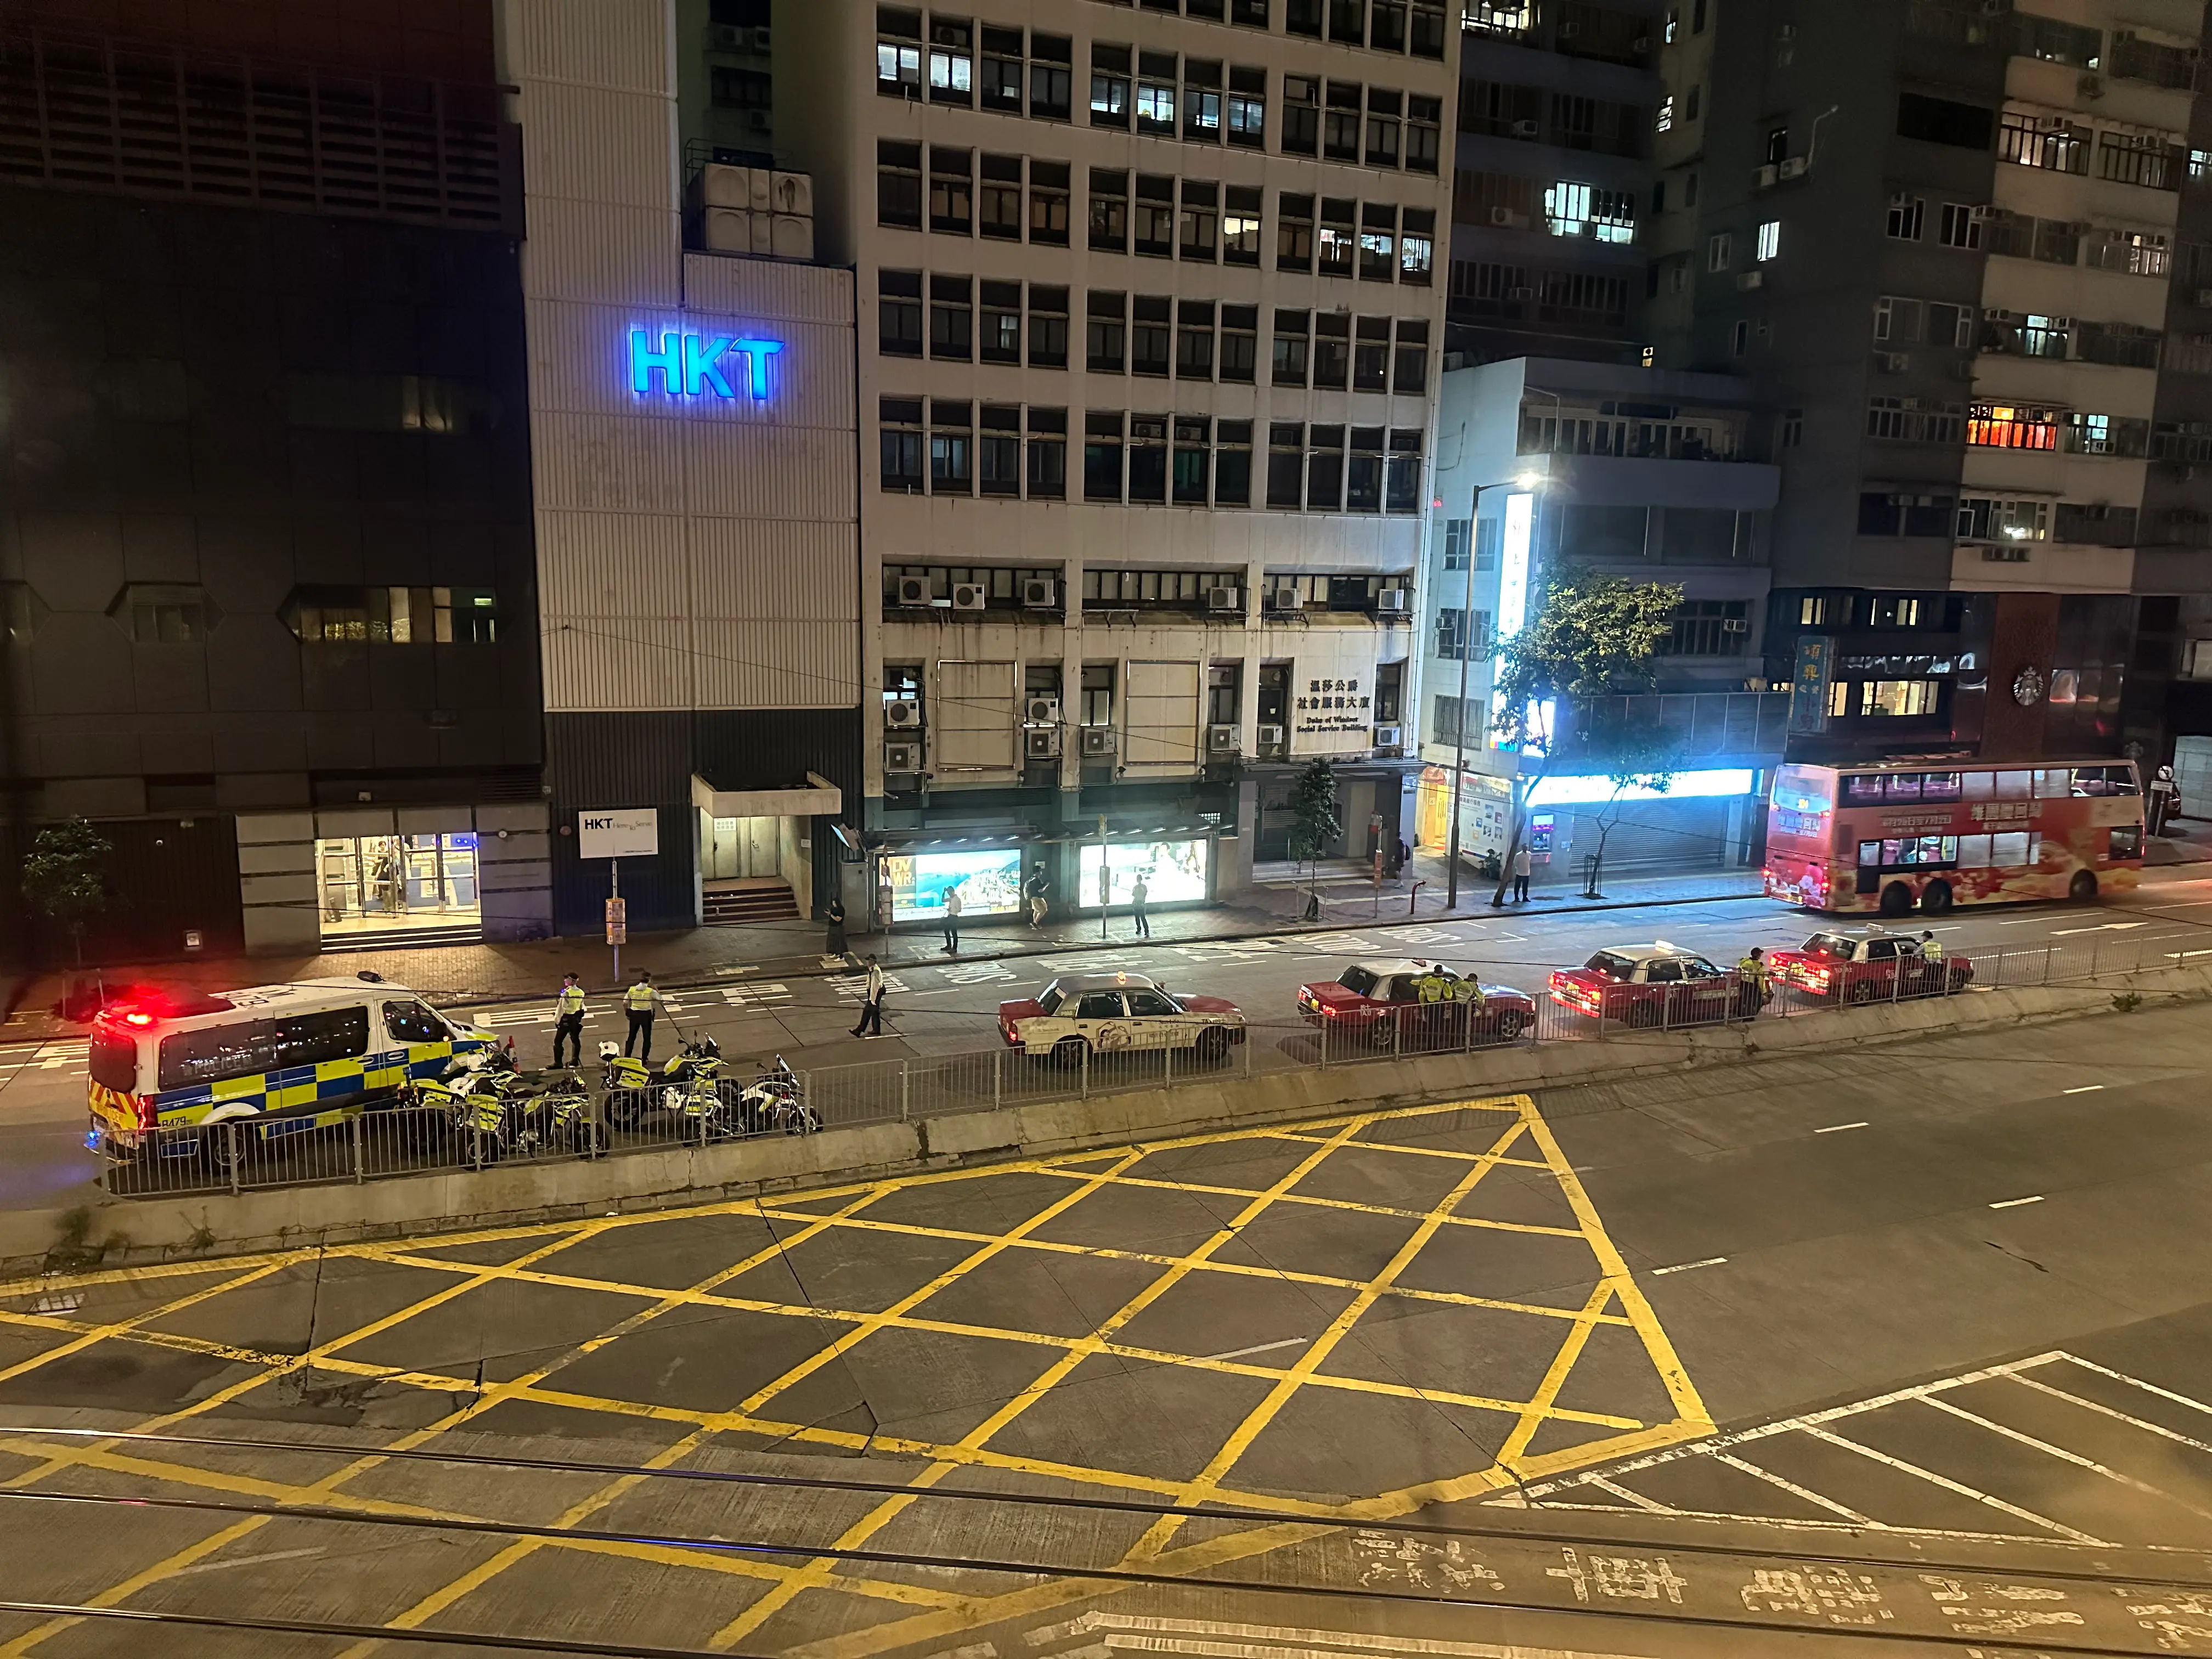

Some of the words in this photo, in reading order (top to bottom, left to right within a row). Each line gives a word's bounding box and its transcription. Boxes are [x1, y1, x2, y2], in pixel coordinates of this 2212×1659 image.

[631, 330, 785, 400] HKT
[585, 818, 613, 830] HKT
[1291, 934, 1381, 952] STOP
[1378, 927, 1462, 944] BUS
[935, 963, 1017, 984] BUS
[195, 1058, 240, 1074] POLICE
